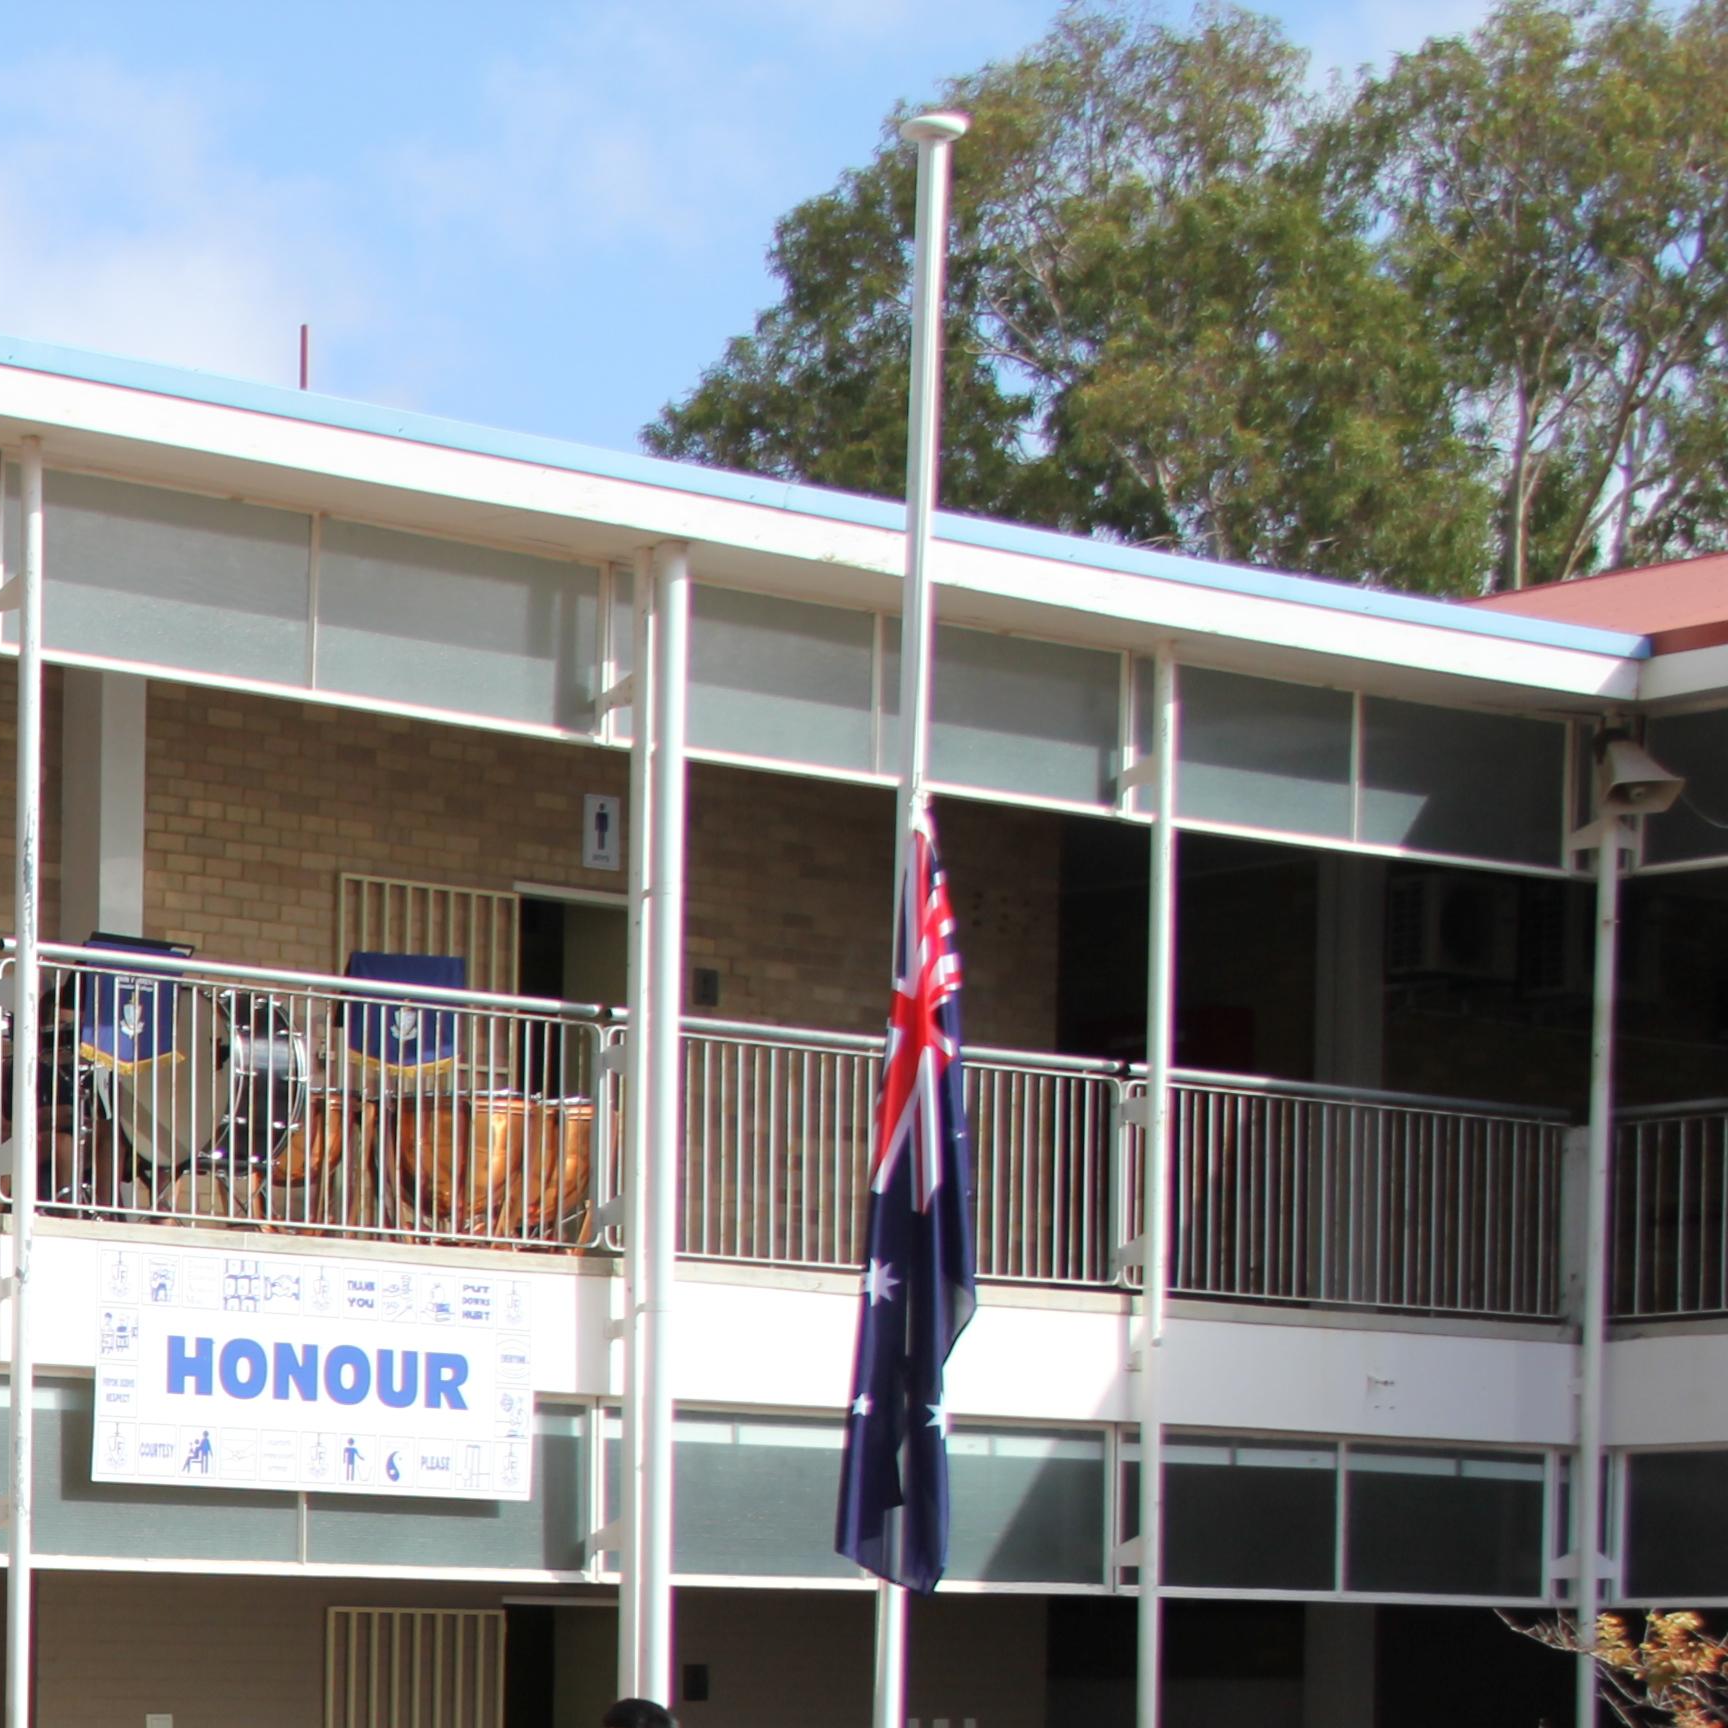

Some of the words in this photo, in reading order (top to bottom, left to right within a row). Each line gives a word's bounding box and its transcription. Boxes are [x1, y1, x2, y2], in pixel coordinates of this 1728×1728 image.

[347, 1297, 374, 1309] YOU
[166, 1335, 469, 1411] HONOUR
[140, 1442, 174, 1458] COURTESY
[421, 1455, 450, 1471] PLEASE
